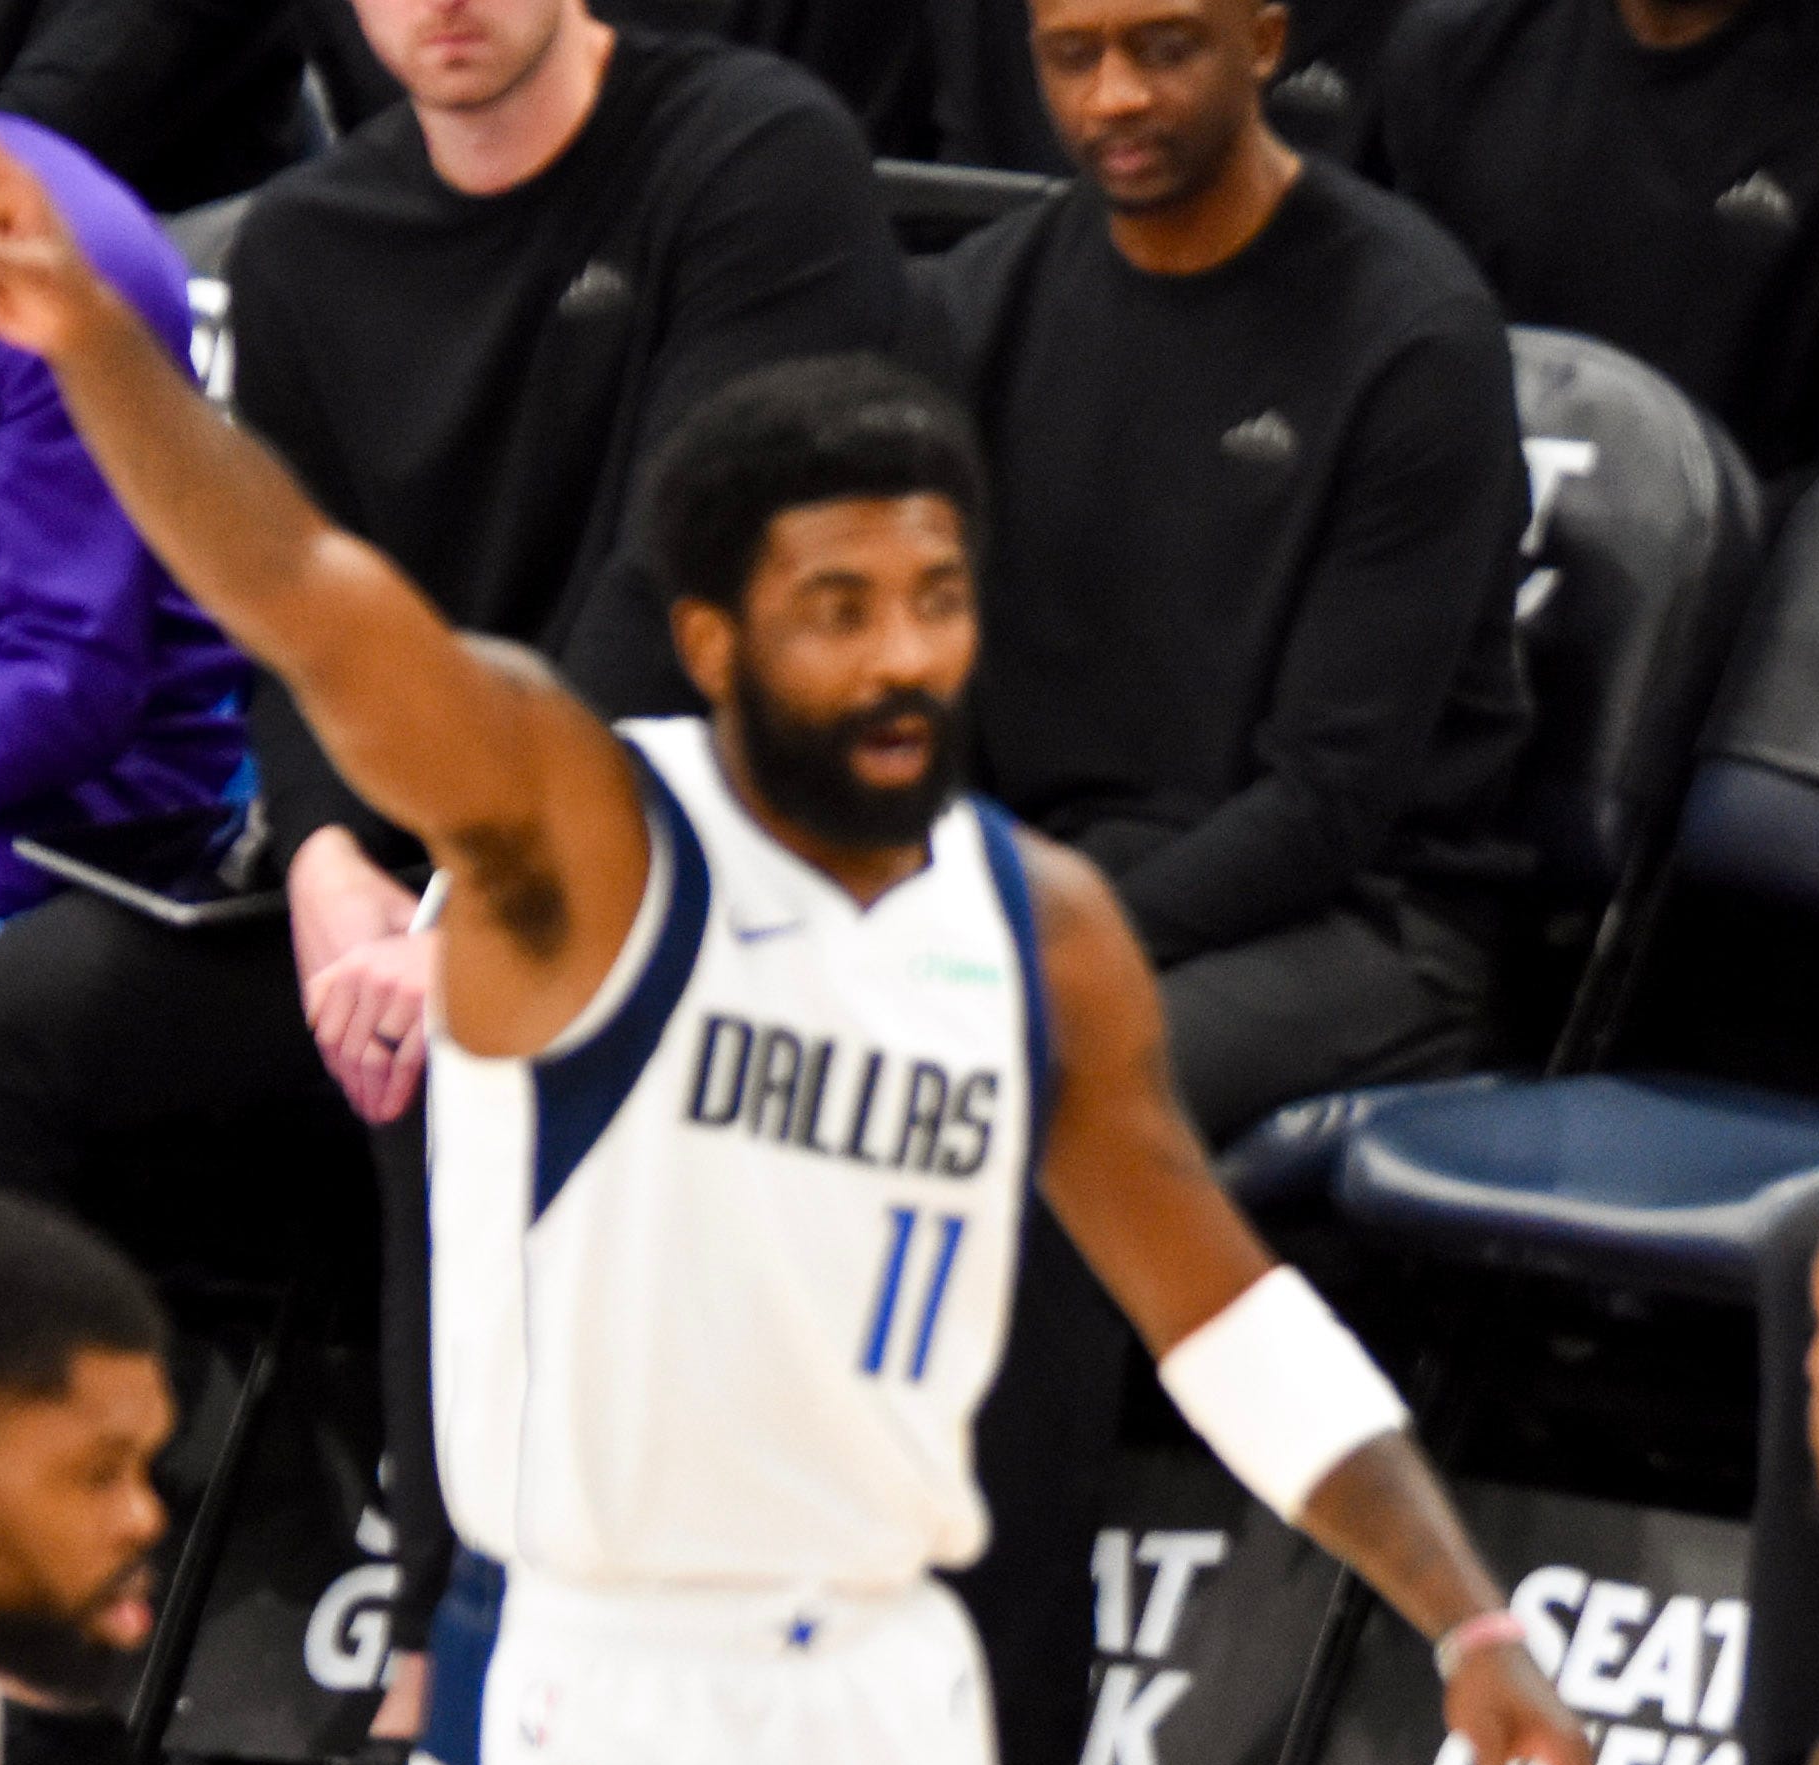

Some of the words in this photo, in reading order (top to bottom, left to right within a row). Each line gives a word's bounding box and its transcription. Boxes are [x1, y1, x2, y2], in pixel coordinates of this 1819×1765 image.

[686, 1012, 999, 1180] DALLAS
[861, 1206, 966, 1382] 11
[1509, 1565, 1750, 1732] SEAT
